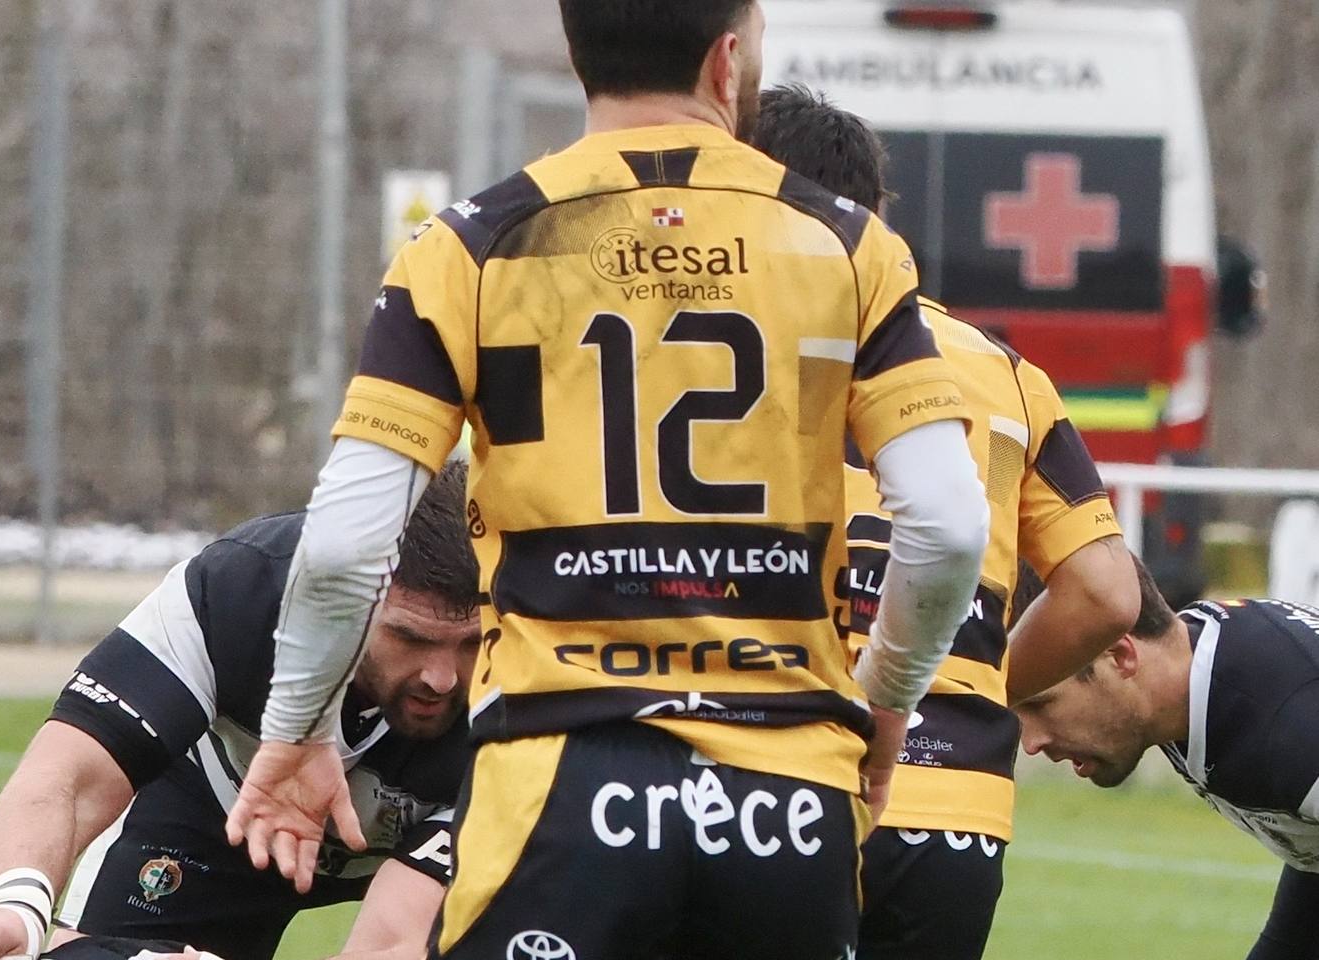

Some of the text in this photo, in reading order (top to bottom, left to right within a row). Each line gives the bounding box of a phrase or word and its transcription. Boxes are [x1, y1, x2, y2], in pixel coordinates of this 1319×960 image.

[779, 53, 1102, 88] AMBULANCIA
[616, 237, 749, 276] itesal
[621, 279, 734, 301] ventanas
[580, 310, 768, 516] 12
[370, 417, 431, 449] BURGOS
[554, 541, 809, 577] CASTILLA Y LEÓN
[614, 581, 739, 599] NOS IMPULSA
[590, 768, 824, 857] crece
